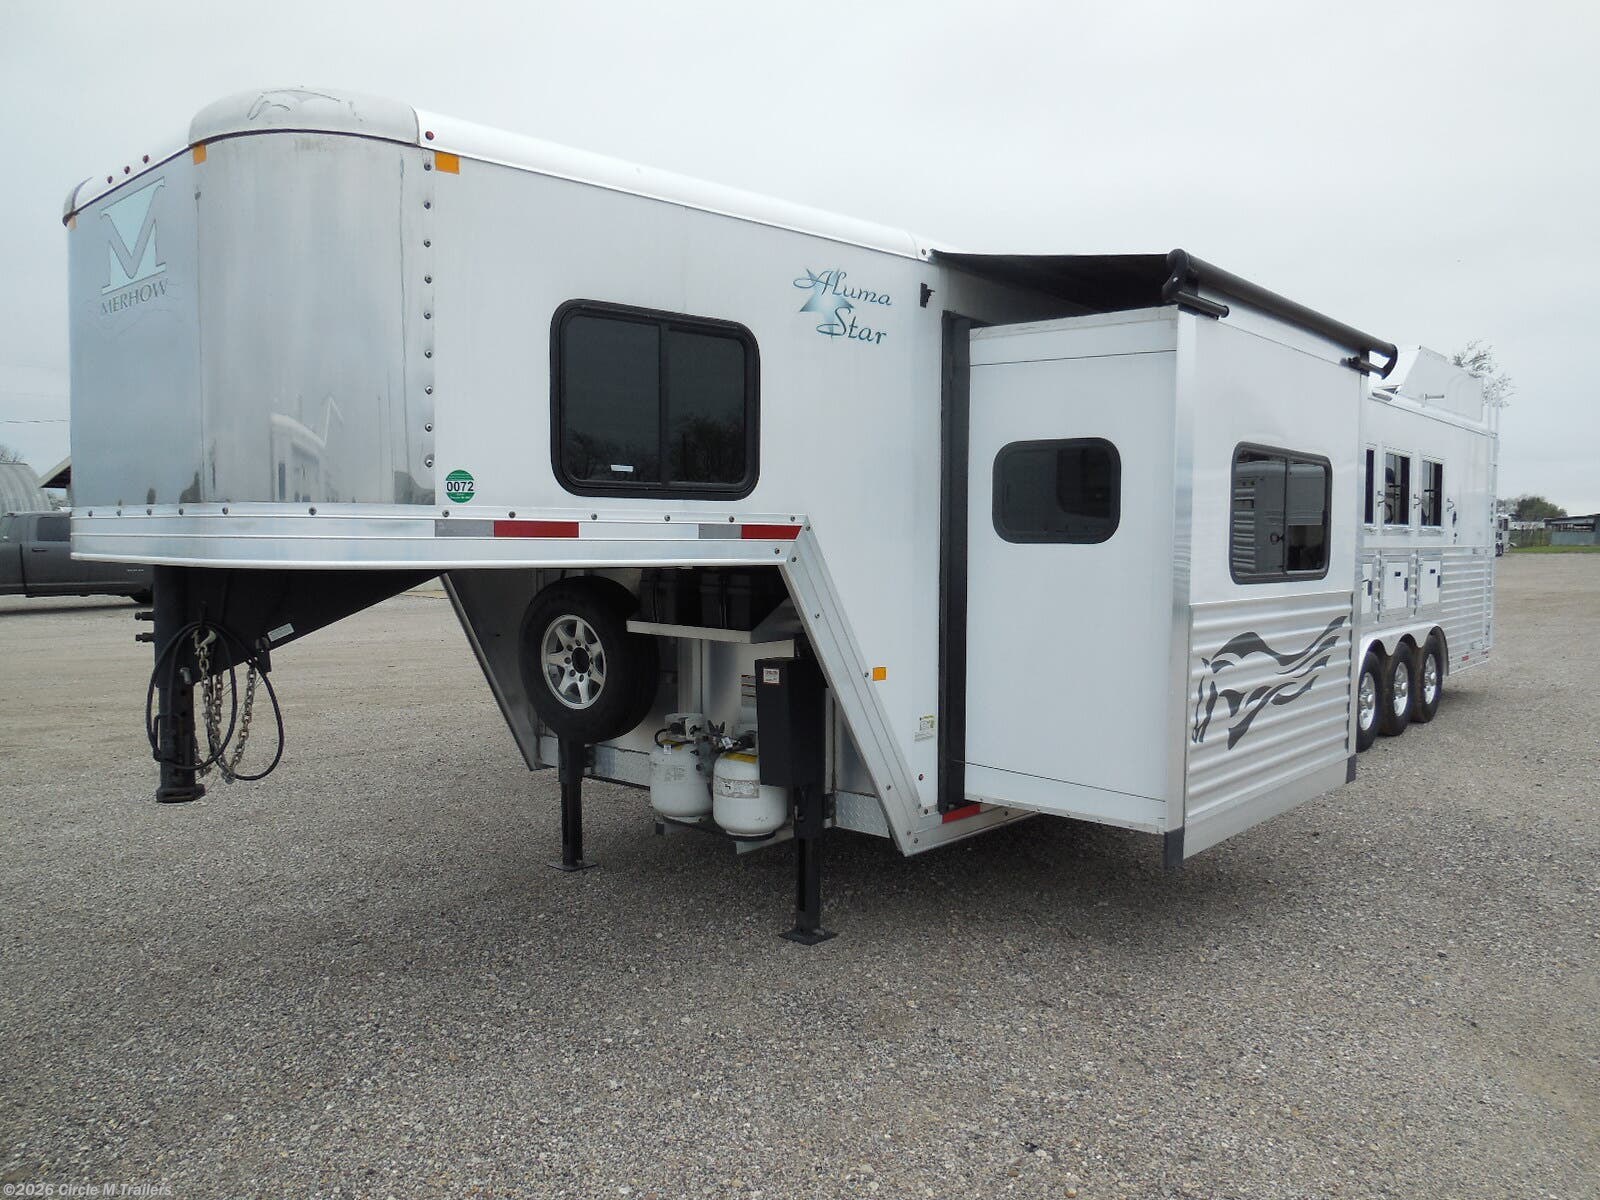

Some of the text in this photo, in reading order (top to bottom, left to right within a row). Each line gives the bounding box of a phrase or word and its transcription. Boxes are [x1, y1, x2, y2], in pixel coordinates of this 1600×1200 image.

[101, 277, 168, 314] MERHOW
[792, 270, 892, 306] Aluma
[816, 306, 887, 344] Star
[446, 481, 474, 492] 0072
